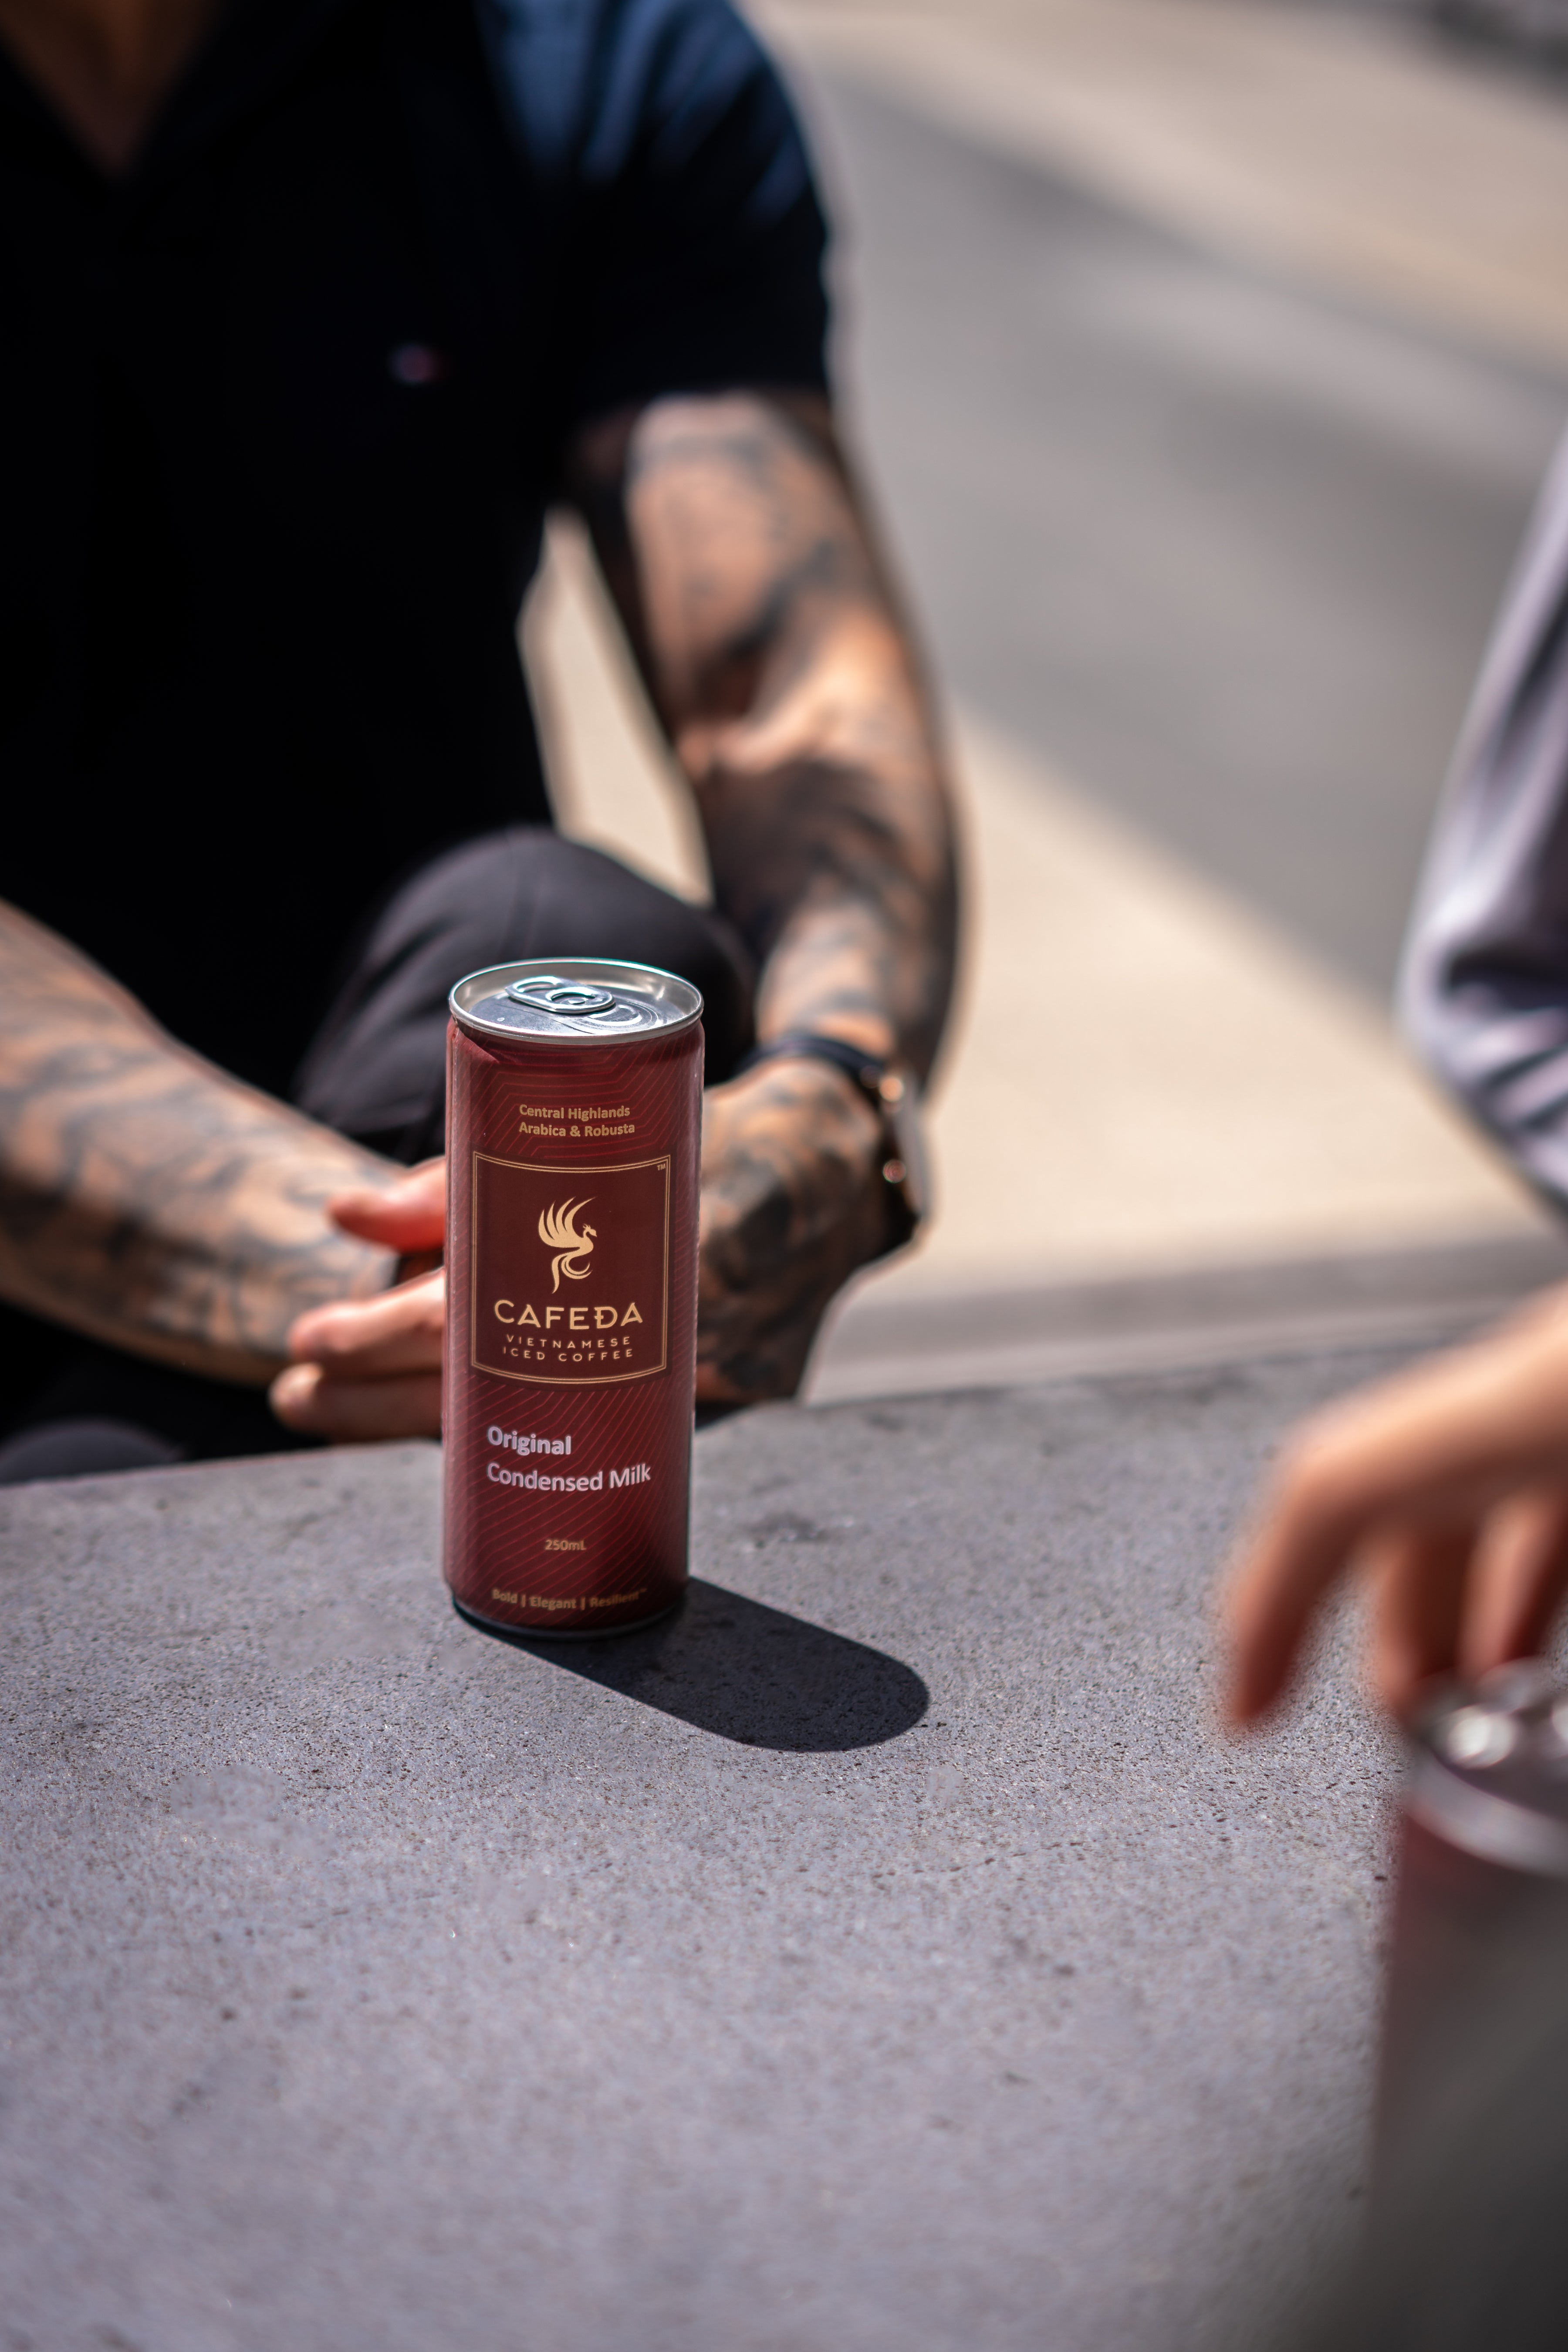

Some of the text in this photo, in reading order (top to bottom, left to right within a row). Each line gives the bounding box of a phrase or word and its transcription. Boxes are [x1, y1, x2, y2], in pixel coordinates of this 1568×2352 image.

[519, 1104, 630, 1121] Central Highlands
[519, 1122, 635, 1137] Arabica & Robusta
[507, 1334, 630, 1348] VIETNAMESE
[503, 1346, 632, 1362] ICED COFFEE
[487, 1426, 571, 1455] Original
[487, 1462, 651, 1491] Condensed Milk
[545, 1540, 586, 1551] 250mL
[493, 1589, 517, 1603] Bold
[530, 1596, 577, 1610] Elegant
